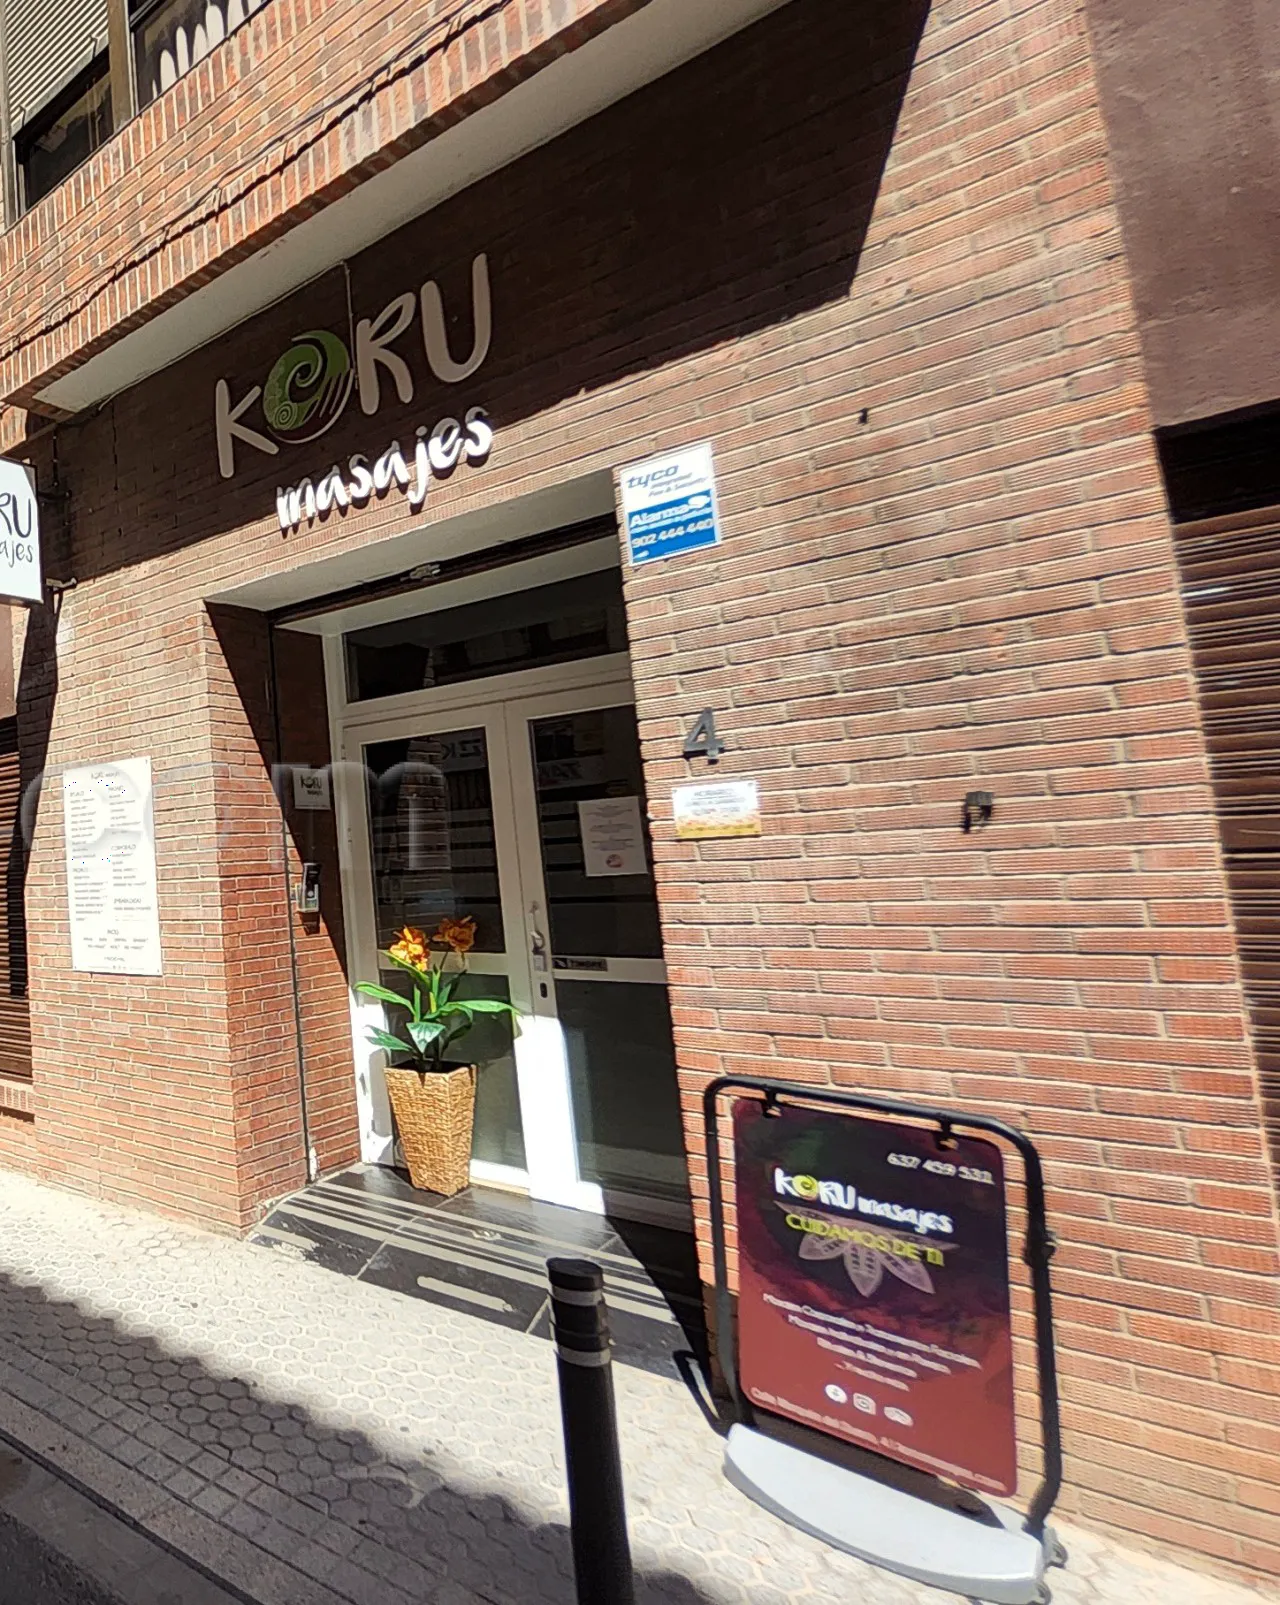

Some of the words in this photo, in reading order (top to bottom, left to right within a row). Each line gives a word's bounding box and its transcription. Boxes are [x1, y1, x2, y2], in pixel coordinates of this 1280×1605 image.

[216, 253, 492, 479] KORU
[276, 407, 493, 529] masajes
[625, 465, 679, 488] tyco
[685, 707, 723, 760] 4
[774, 1167, 856, 1210] KORU
[857, 1196, 953, 1234] masajes
[785, 1213, 889, 1252] CUIDAMOS
[890, 1239, 922, 1261] DE
